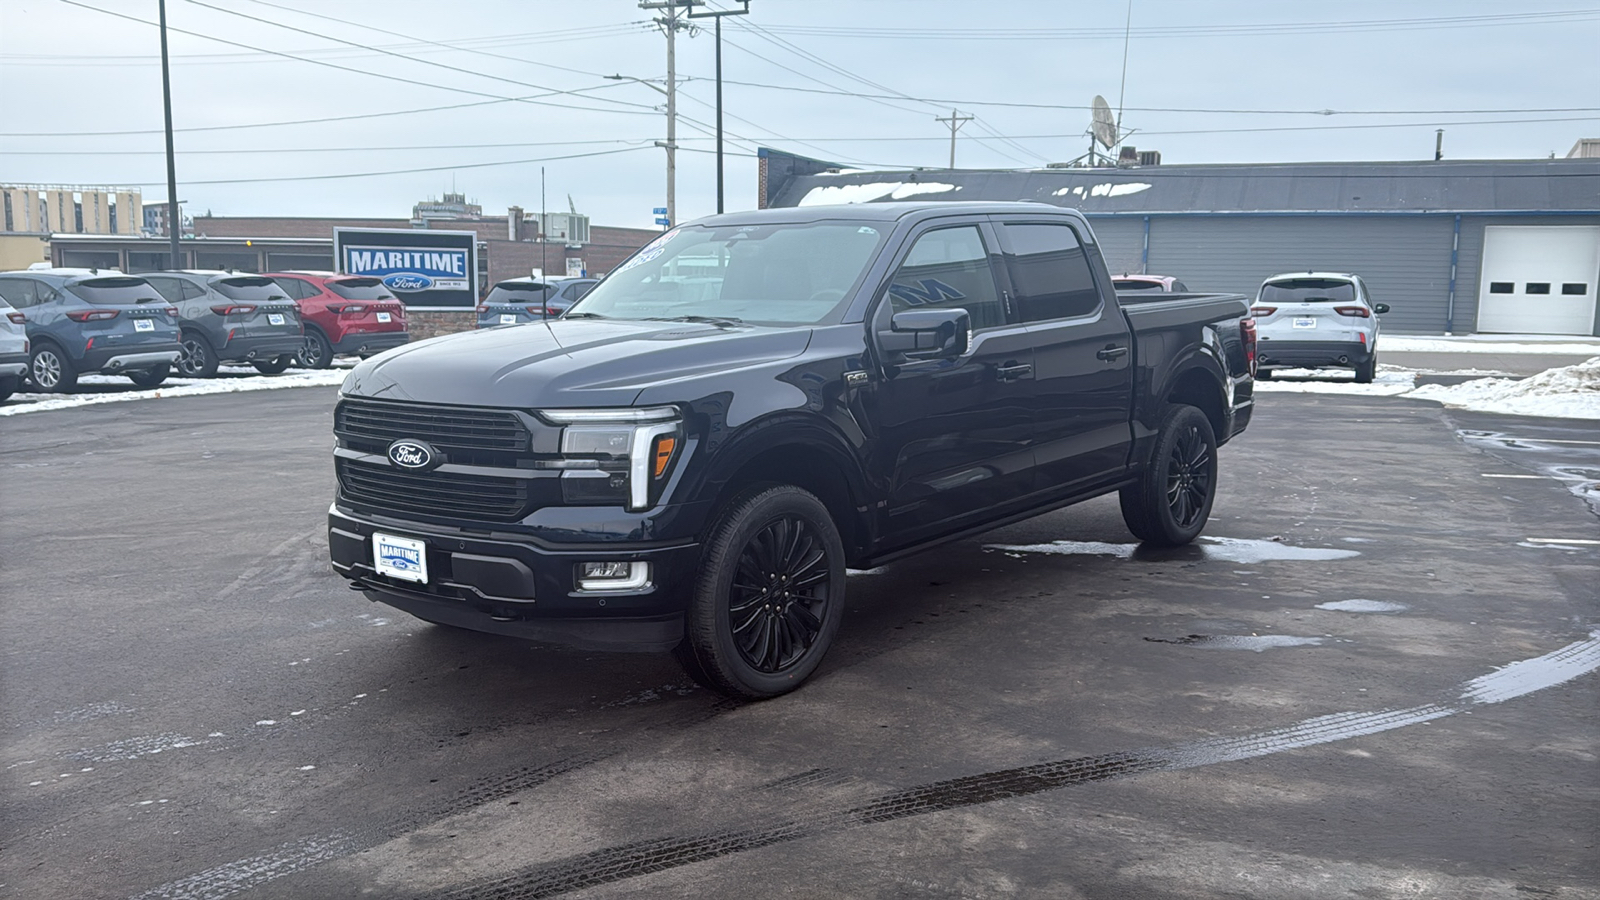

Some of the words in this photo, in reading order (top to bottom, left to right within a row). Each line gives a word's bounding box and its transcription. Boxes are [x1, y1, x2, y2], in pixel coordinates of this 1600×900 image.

[351, 251, 463, 275] MARITIME
[392, 277, 422, 289] Ford
[396, 445, 422, 464] Ford
[381, 544, 419, 564] MARITIME
